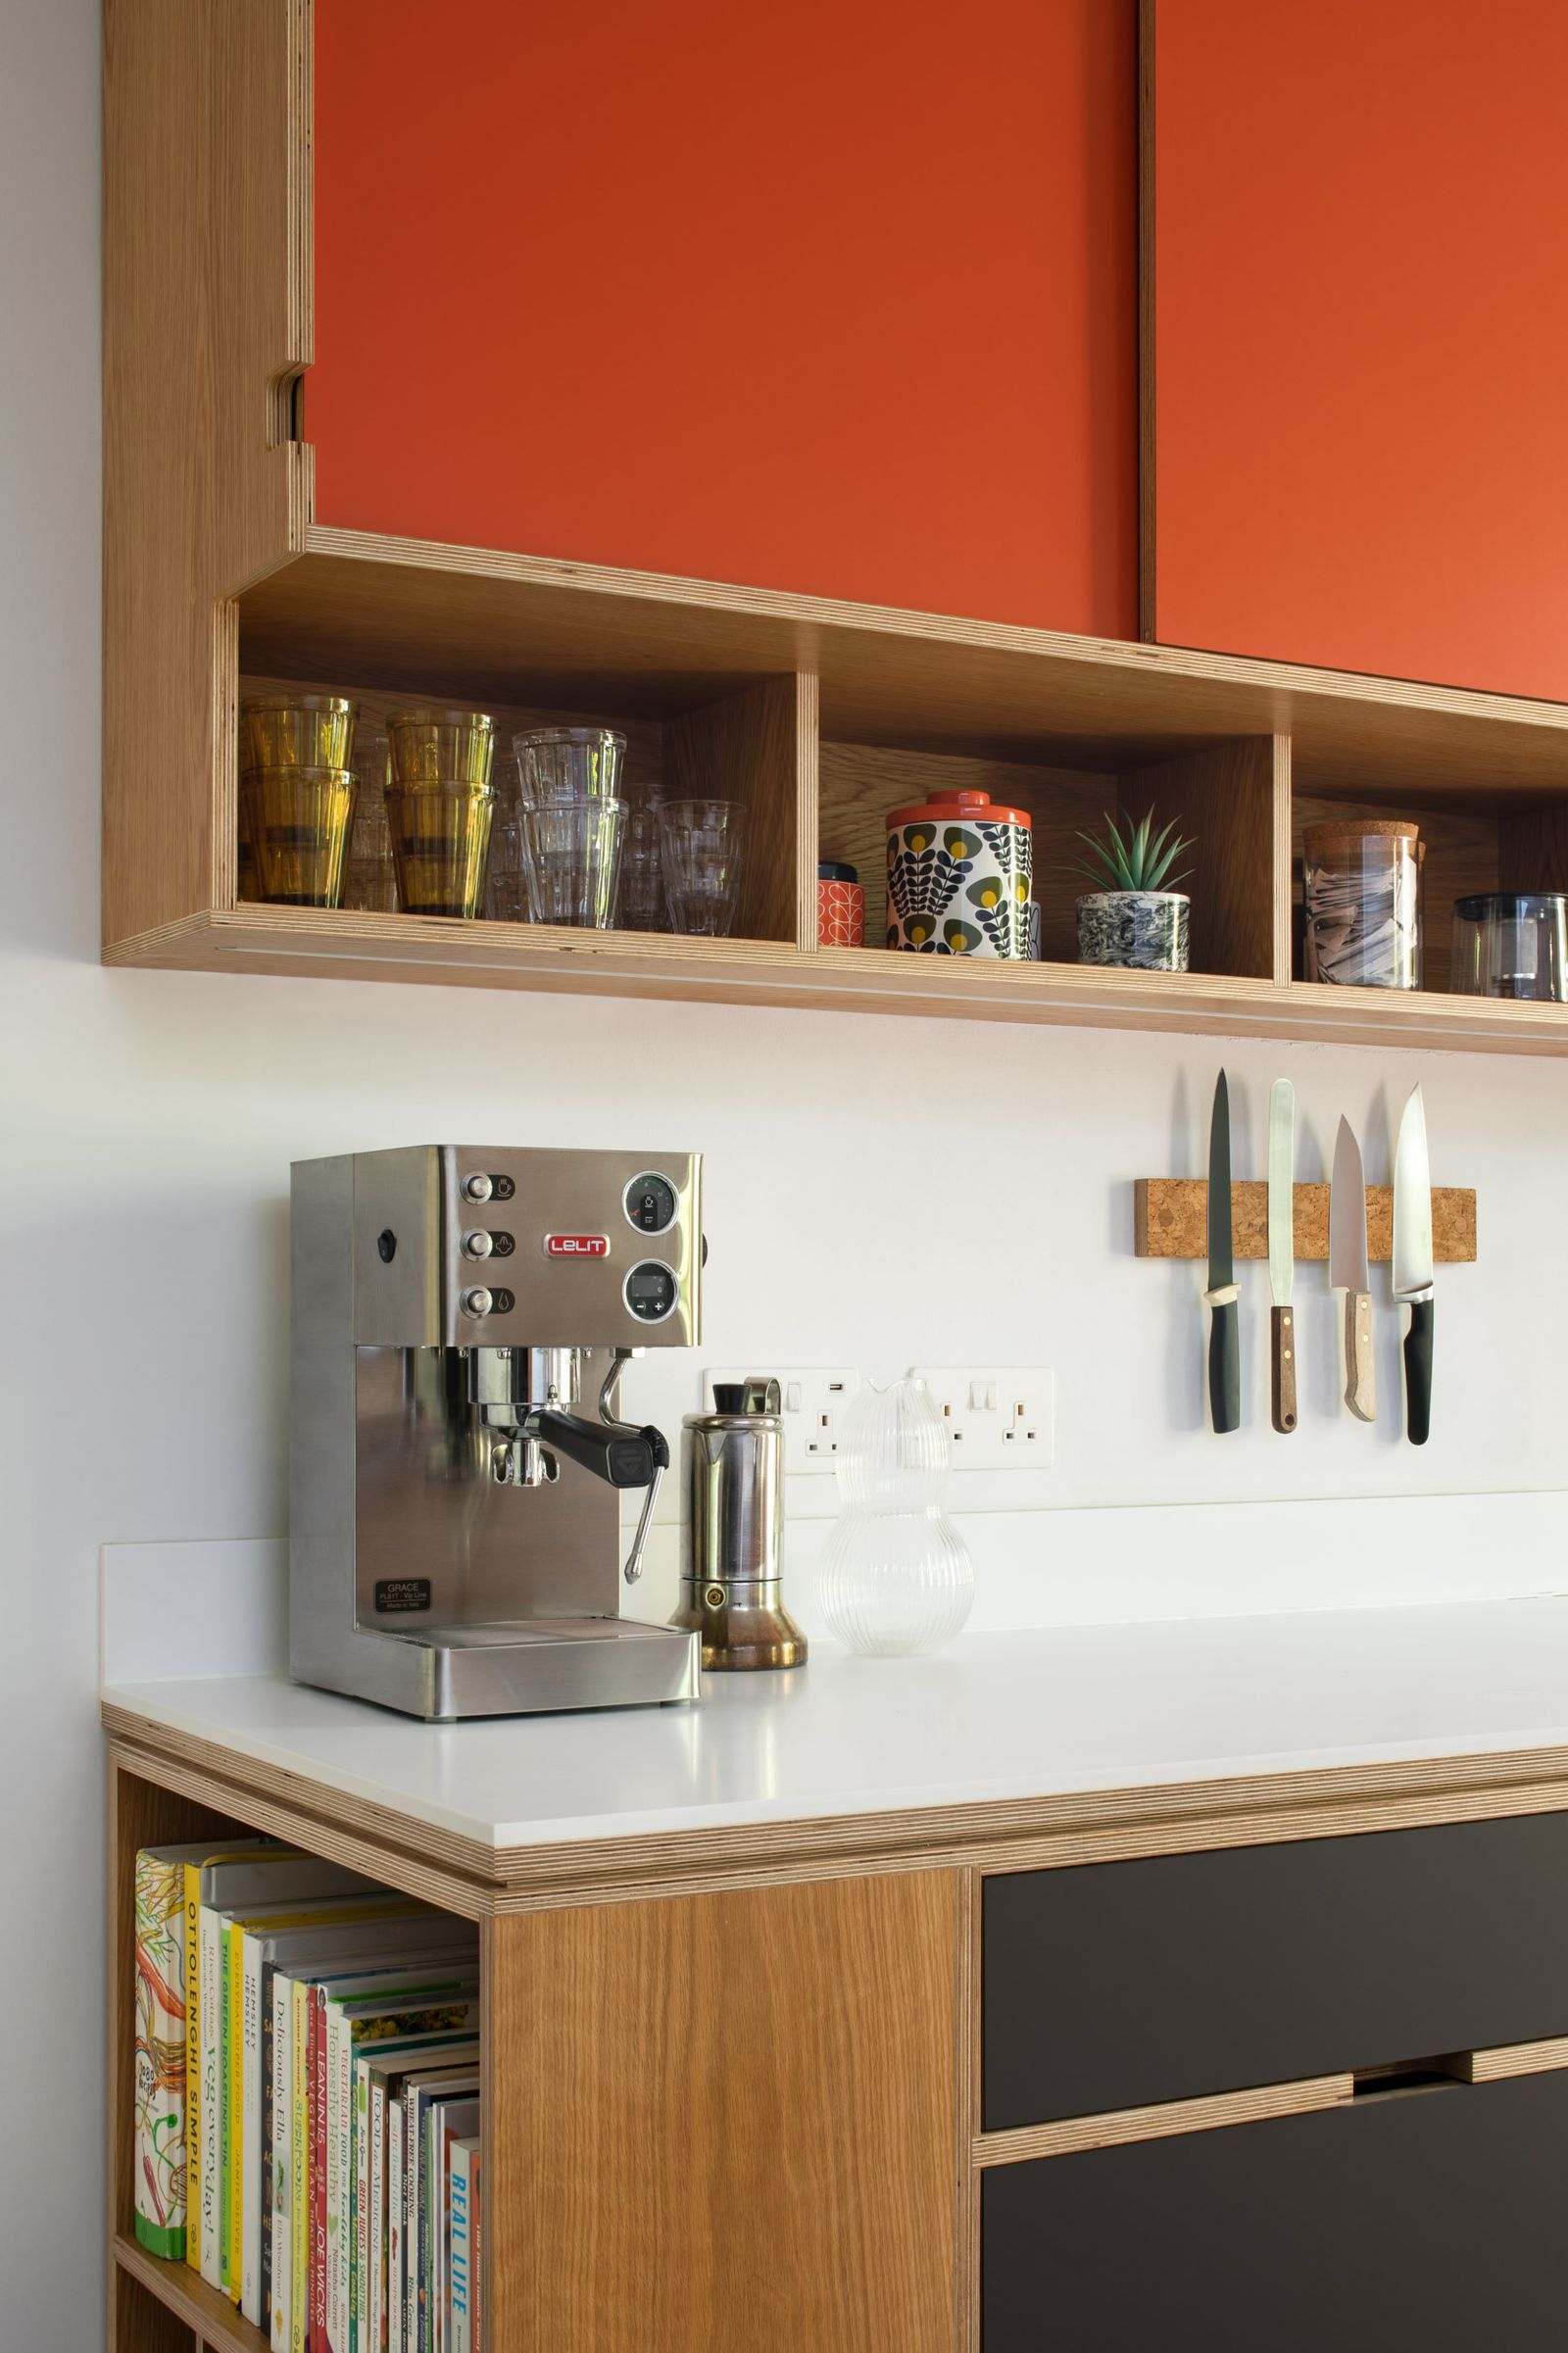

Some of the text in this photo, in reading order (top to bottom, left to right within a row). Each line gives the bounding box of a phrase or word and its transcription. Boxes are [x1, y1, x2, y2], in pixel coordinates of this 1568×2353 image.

[387, 1583, 419, 1593] GRACE
[189, 1901, 198, 2076] OTTOLENGHI
[274, 2000, 285, 2101] Deliciously
[318, 2103, 325, 2125] IN
[318, 2126, 325, 2145] 15
[328, 2023, 339, 2205] Honestly Healthy
[339, 2191, 348, 2253] healthy
[452, 2172, 466, 2241] REAL
[310, 2250, 315, 2265] IN
[452, 2251, 466, 2316] LIFE
